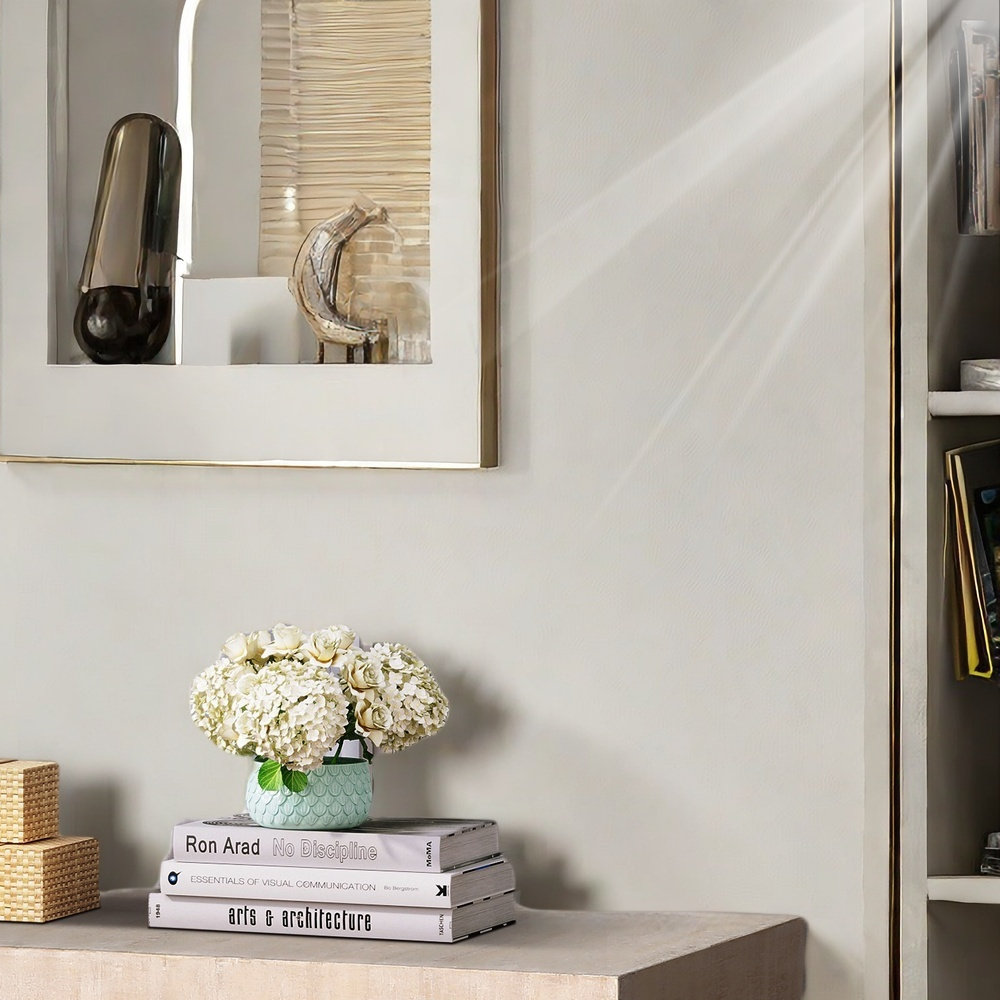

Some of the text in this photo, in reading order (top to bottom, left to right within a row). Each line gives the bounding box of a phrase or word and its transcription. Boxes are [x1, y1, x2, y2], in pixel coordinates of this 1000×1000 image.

[186, 835, 377, 863] Ron Arad No Discipline
[190, 876, 376, 891] ESSENTIALS OF VISUAL COMMUNICATION
[228, 906, 372, 931] arts & architecture
